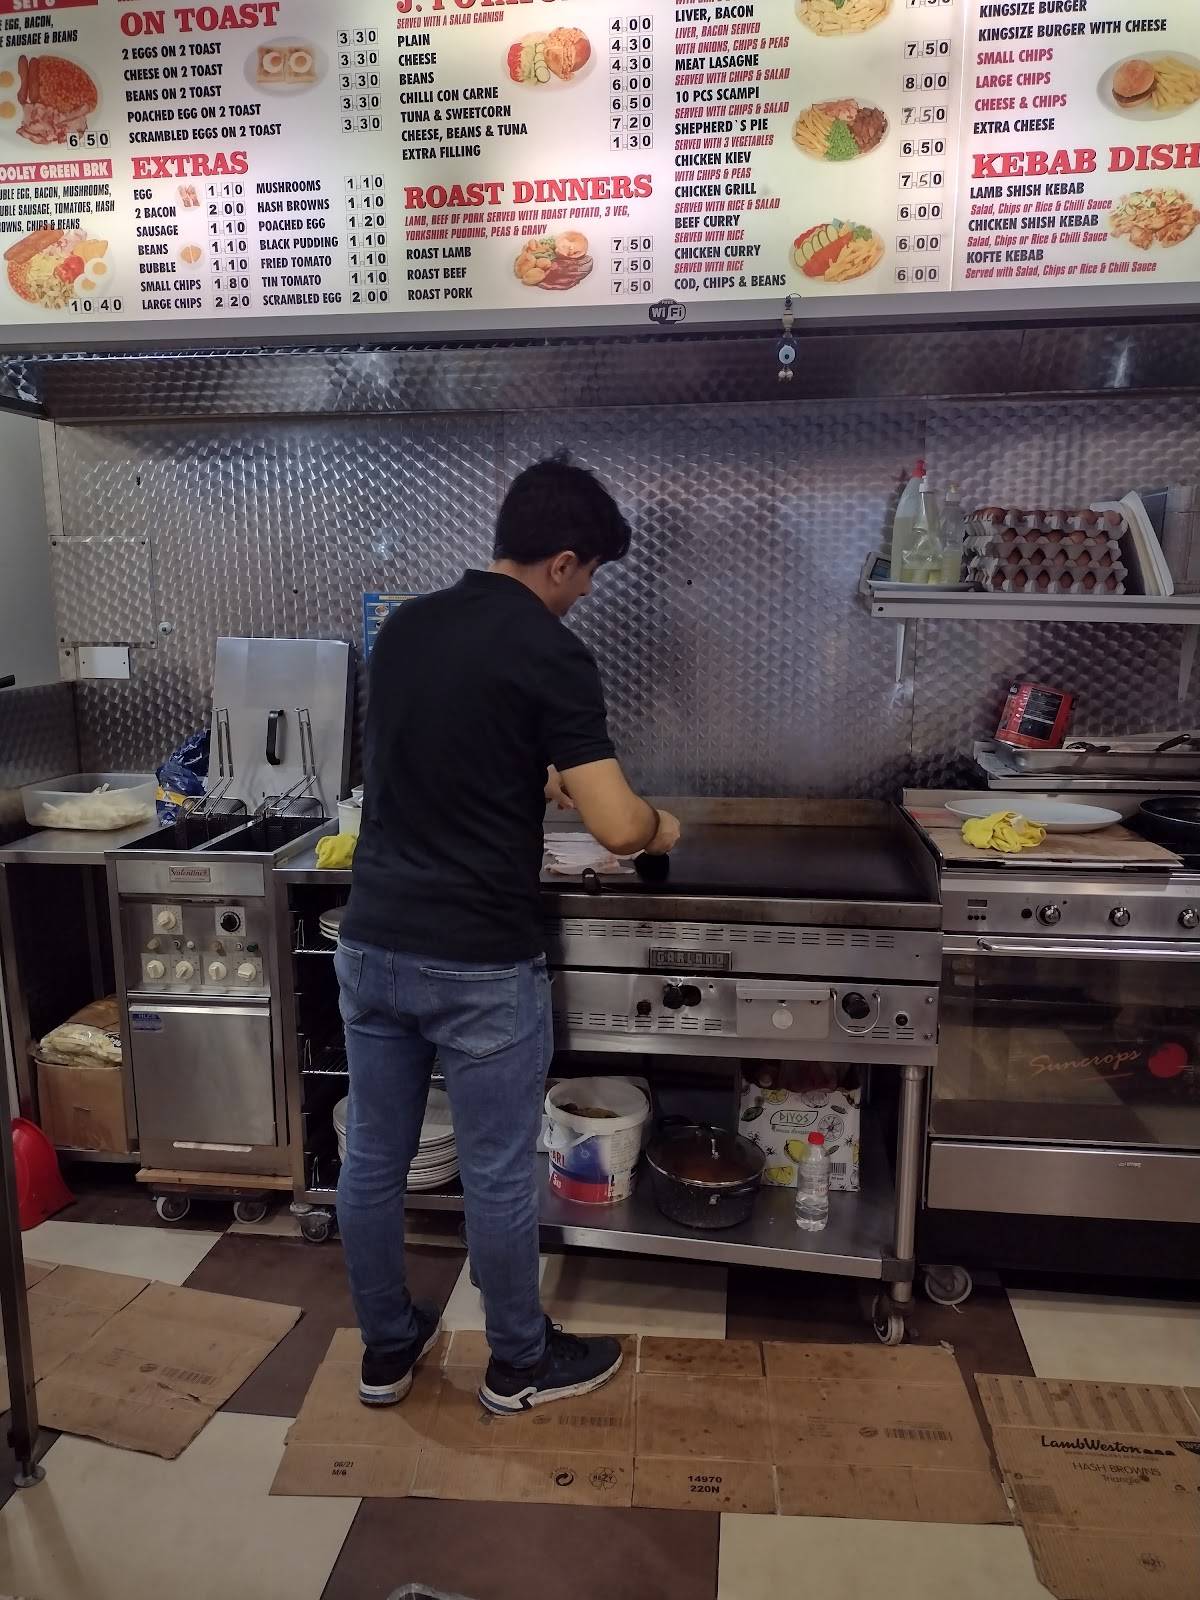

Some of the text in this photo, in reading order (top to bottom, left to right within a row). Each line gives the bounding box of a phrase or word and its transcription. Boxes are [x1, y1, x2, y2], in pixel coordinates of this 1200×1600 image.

[675, 6, 754, 23] LIVER, BACON
[979, 0, 1087, 18] KINGSIZE BURGER
[120, 2, 280, 37] ON TOAST
[396, 11, 503, 30] SERVED WITH A SALAD GARNISH
[978, 20, 1166, 41] KINGSIZE BURGER WITH CHEESE
[397, 33, 430, 48] PLAIN
[121, 43, 221, 61] 2 EGGS ON 2 TOAST
[977, 49, 1053, 65] SMALL CHIPS
[398, 53, 437, 67] CHEESE
[675, 55, 759, 70] MEAT LASAGNE
[123, 64, 222, 82] CHEESE ON 2 TOAST
[399, 72, 434, 85] BEANS
[976, 72, 1051, 88] LARGE CHIPS
[125, 85, 221, 103] BEANS ON 2 TOAST
[399, 87, 499, 104] CHILLI CON CARNE
[675, 88, 759, 103] 10 PCS SCAMPI
[974, 95, 1067, 111] CHEESE & CHIPS
[127, 104, 260, 123] POACHED EGG ON 2 TOAST
[400, 105, 511, 123] TUNA & SWEETCORN
[750, 119, 768, 131] PIE
[973, 119, 1055, 134] EXTRA CHEESE
[128, 124, 281, 144] SCRAMBLED EGGS ON 2 TOAST
[401, 124, 528, 143] CHEESE, BEANS & TUNA
[675, 135, 773, 150] SERVED WITH 3 VEGETABLES
[402, 145, 481, 161] EXTRA FILLING
[674, 152, 750, 166] CHICKEN KIEV
[40, 163, 80, 179] GREEN
[83, 161, 109, 177] BRK
[131, 151, 249, 180] EXTRAS
[971, 148, 1097, 179] KEBAB
[16, 184, 112, 201] EGG, BACON, MUSHROOMS,
[133, 188, 152, 200] EGG
[256, 179, 321, 194] MUSHROOMS
[404, 174, 653, 210] ROAST DINNERS
[674, 183, 757, 198] CHICKEN GRILL
[970, 183, 1084, 199] LAMB SHISH KEBAB
[18, 201, 115, 217] SAUSAGE, TOMATOES, HASH
[134, 206, 176, 218] 2 BACON
[257, 198, 330, 213] HASH BROWNS
[258, 218, 325, 232] POACHED EGG
[674, 216, 739, 229] BEEF CURRY
[968, 215, 1098, 232] CHICKEN SHISH KEBAB
[136, 224, 179, 237] SAUSAGE
[137, 243, 168, 256] BEANS
[259, 237, 338, 251] BLACK PUDDING
[406, 247, 471, 260] ROAST LAMB
[674, 245, 760, 260] CHICKEN CURRY
[966, 249, 1044, 264] KOFTE KEBAB
[139, 261, 176, 274] BUBBLE
[260, 255, 331, 269] FRIED TOMATO
[261, 274, 321, 288] TIN TOMATO
[406, 267, 466, 280] ROAST BEEF
[140, 279, 201, 293] SMALL CHIPS
[674, 275, 786, 291] COD, CHIPS & BEANS
[262, 292, 342, 306] SCRAMBLED EGG
[407, 287, 473, 300] ROAST PORK
[141, 298, 202, 310] LARGE CHIPS
[1072, 1462, 1162, 1477] HASH BROWNS
[687, 1475, 722, 1484] 14970
[690, 1485, 720, 1494] 220N
